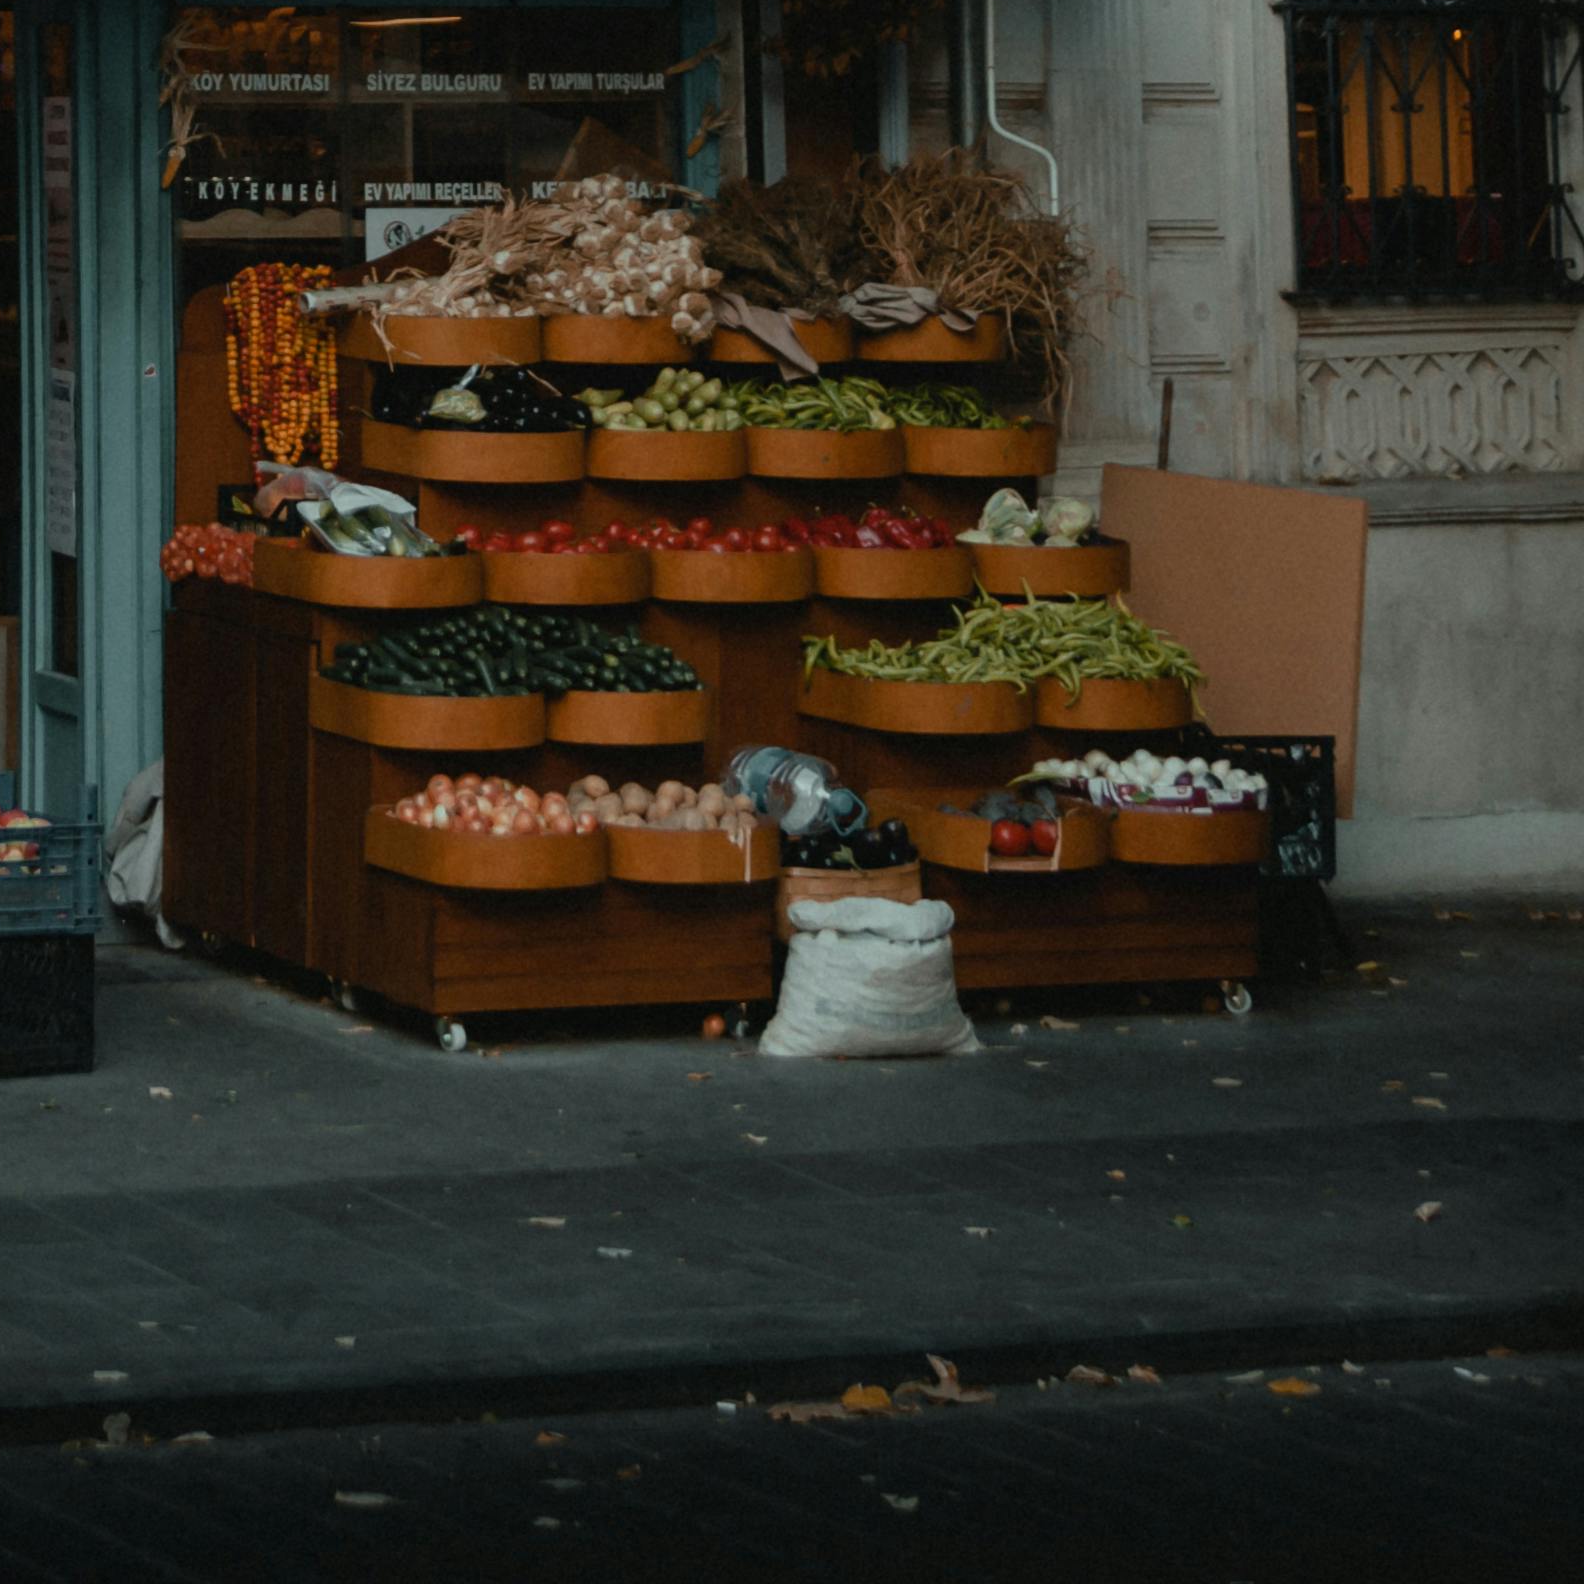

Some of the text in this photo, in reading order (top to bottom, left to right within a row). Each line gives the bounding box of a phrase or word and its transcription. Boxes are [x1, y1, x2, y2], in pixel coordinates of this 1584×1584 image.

[191, 70, 330, 91] KÖY YUMURTASI
[366, 70, 502, 92] SİYEZ BULGURU
[527, 73, 665, 94] EV YAPIMI TURŞULAR
[250, 180, 336, 203] EKMEĞİ
[364, 182, 382, 201] EV
[385, 182, 432, 201] YAPIMI
